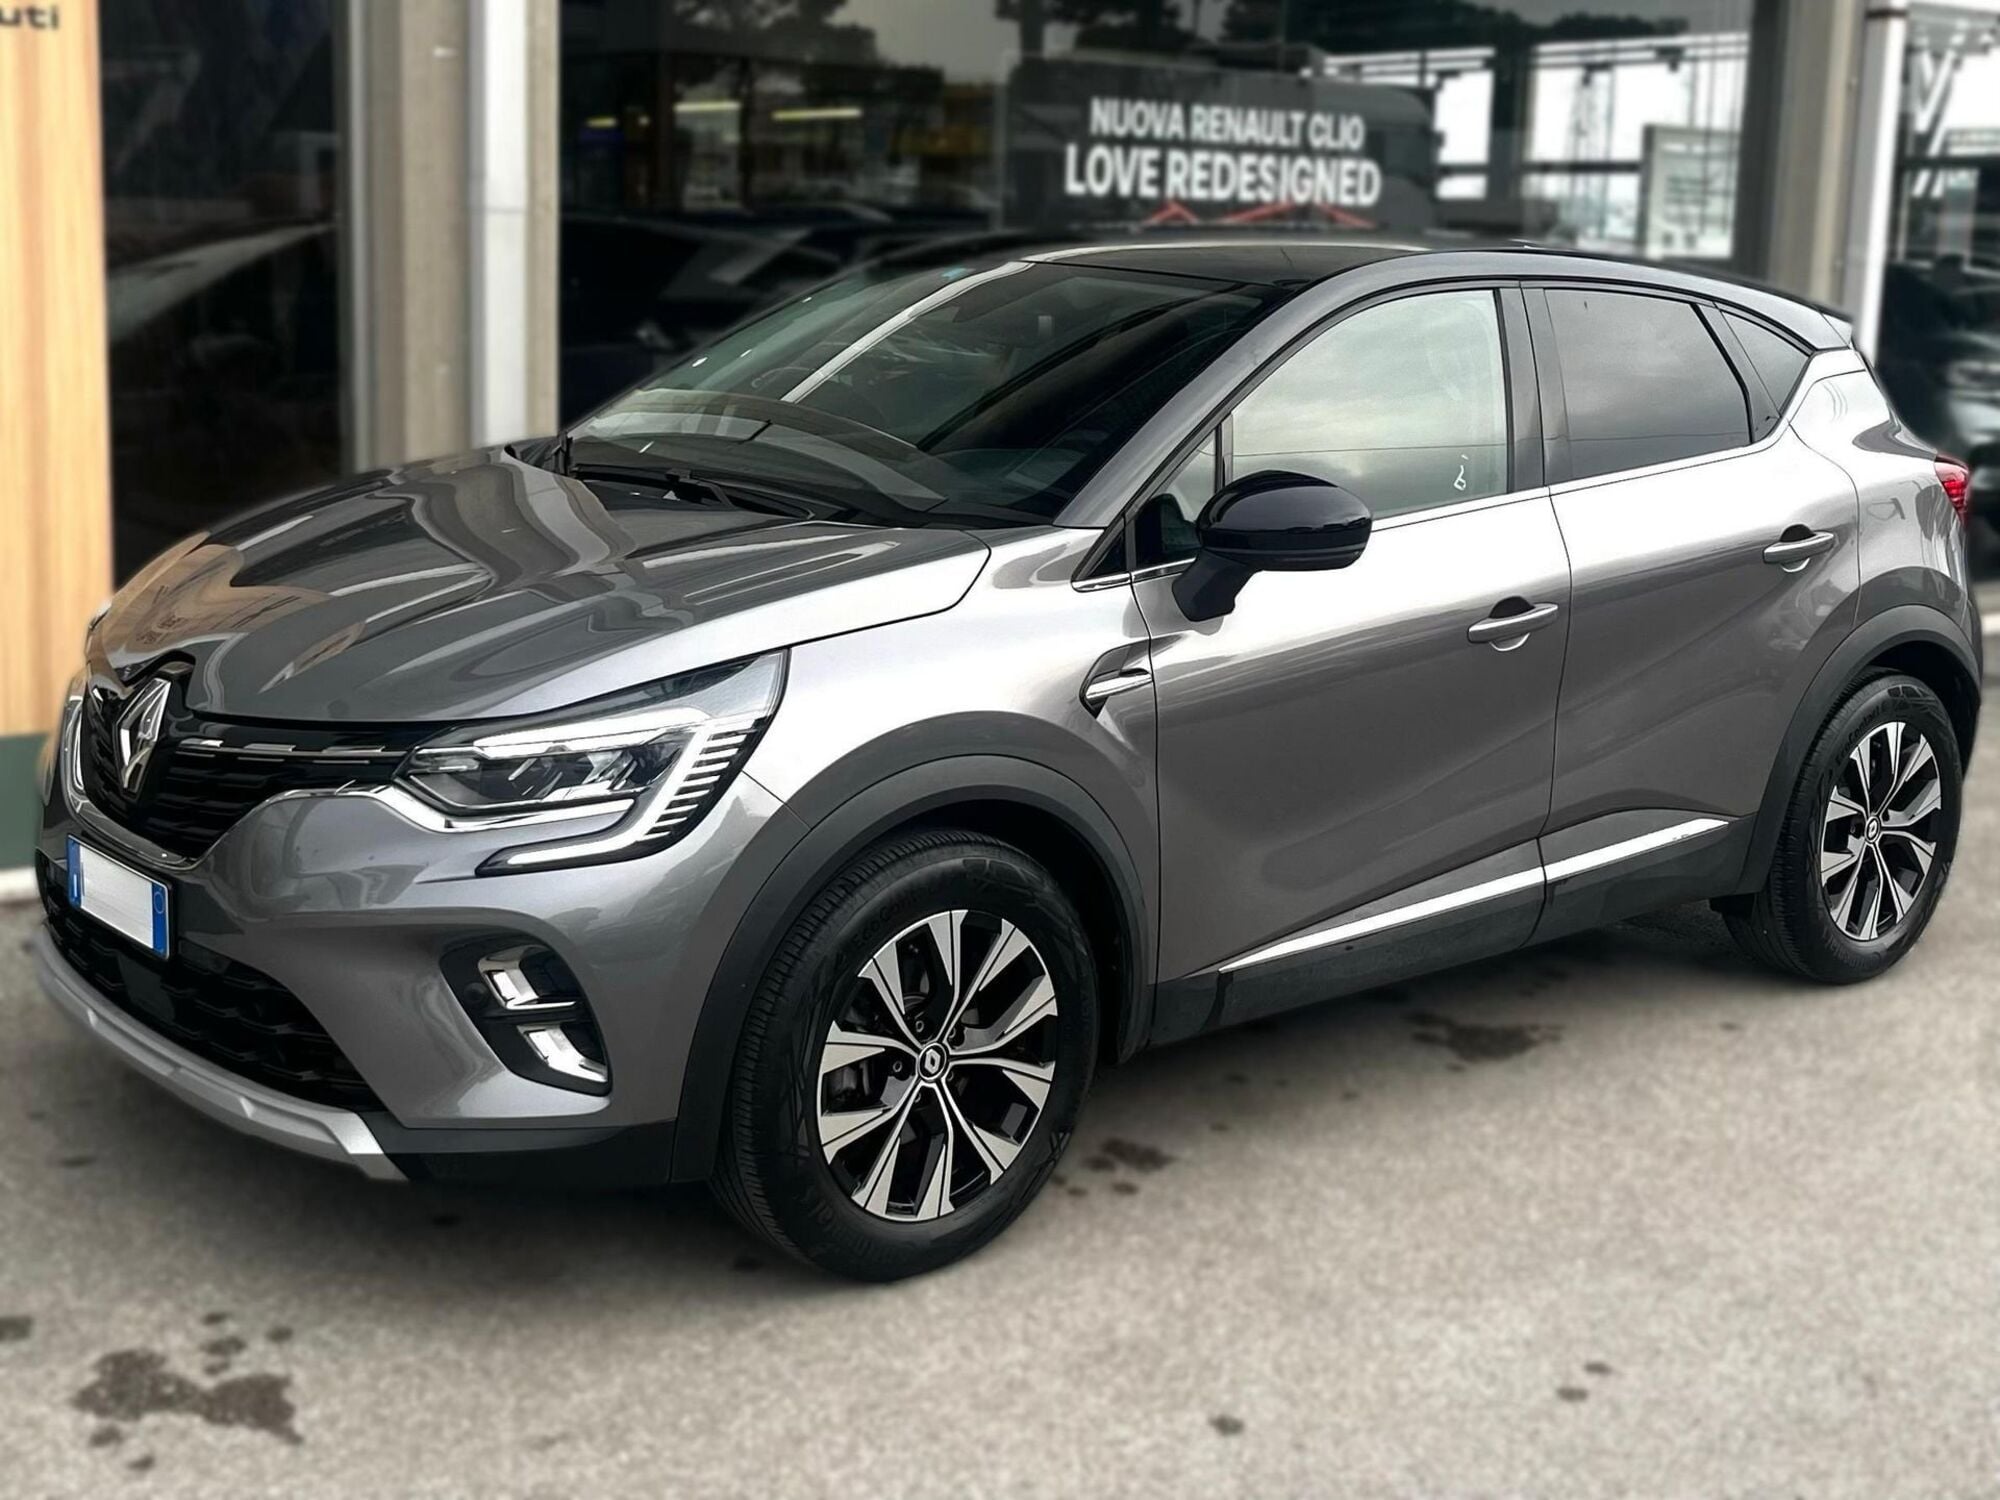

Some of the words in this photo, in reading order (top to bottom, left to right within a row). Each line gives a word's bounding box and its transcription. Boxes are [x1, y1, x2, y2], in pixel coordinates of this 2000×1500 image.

[1090, 97, 1186, 140] NUOVA
[1190, 105, 1306, 147] RENAULT
[1307, 114, 1366, 151] CLIO
[1064, 143, 1162, 198] LOVE
[1165, 149, 1382, 206] REDESIGNED
